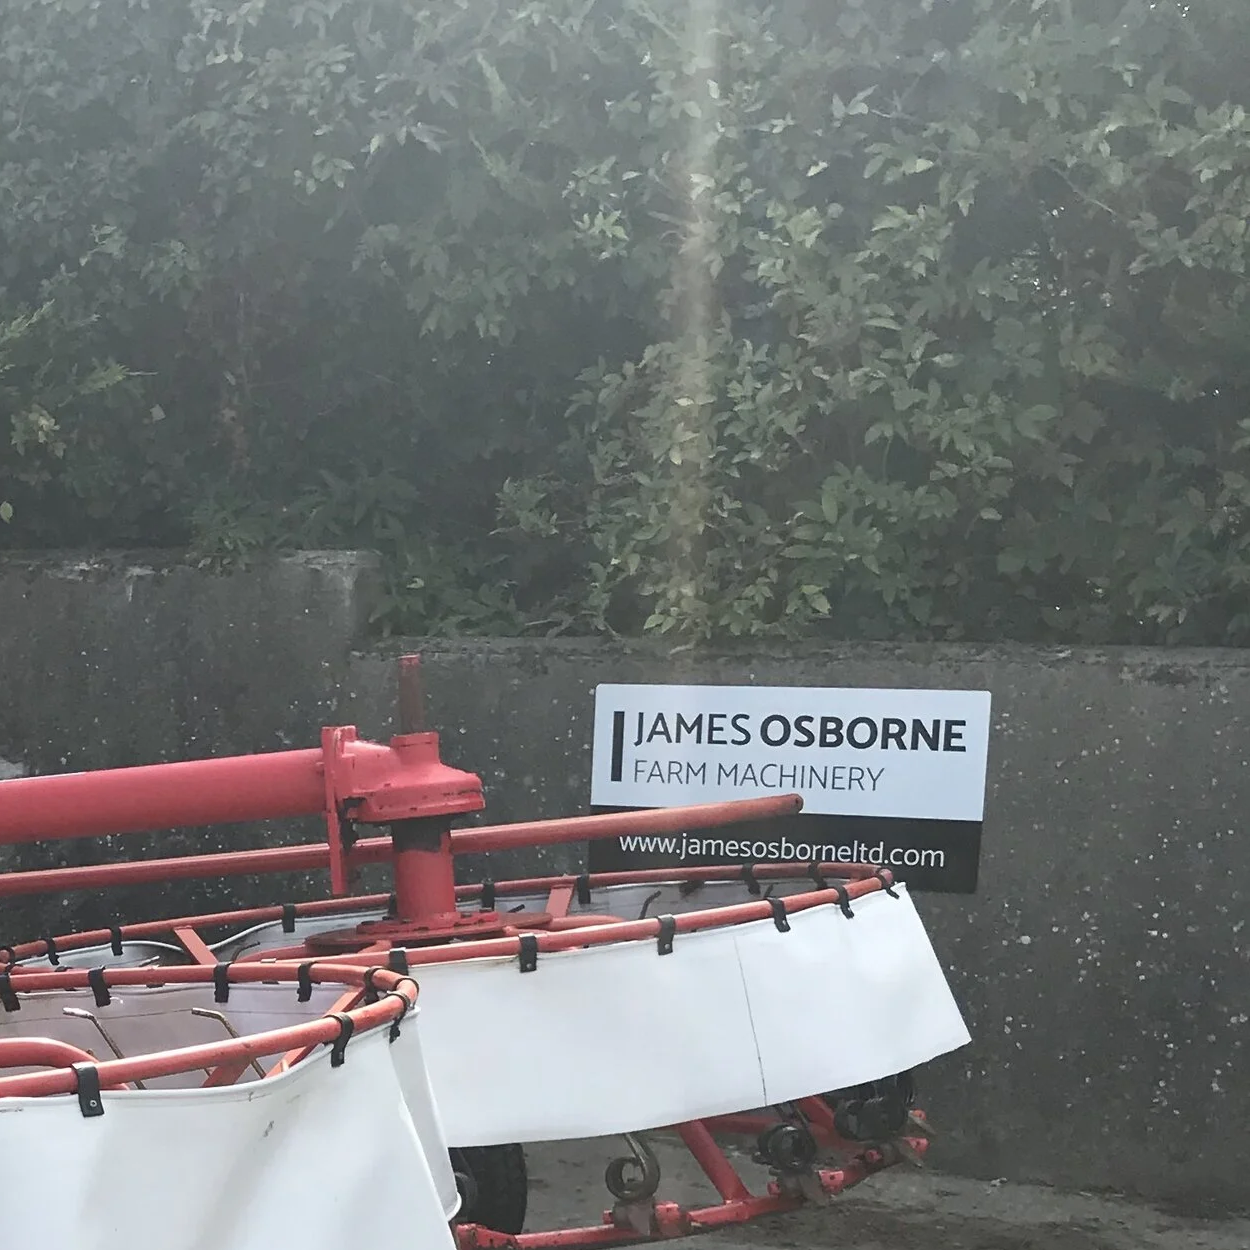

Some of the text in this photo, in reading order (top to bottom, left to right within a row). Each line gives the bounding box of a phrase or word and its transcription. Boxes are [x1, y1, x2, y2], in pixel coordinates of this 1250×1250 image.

[634, 711, 967, 753] JAMES OSBORNE
[633, 759, 886, 792] FARM MACHINERY
[619, 833, 945, 867] www.jamesosborneltd.com
